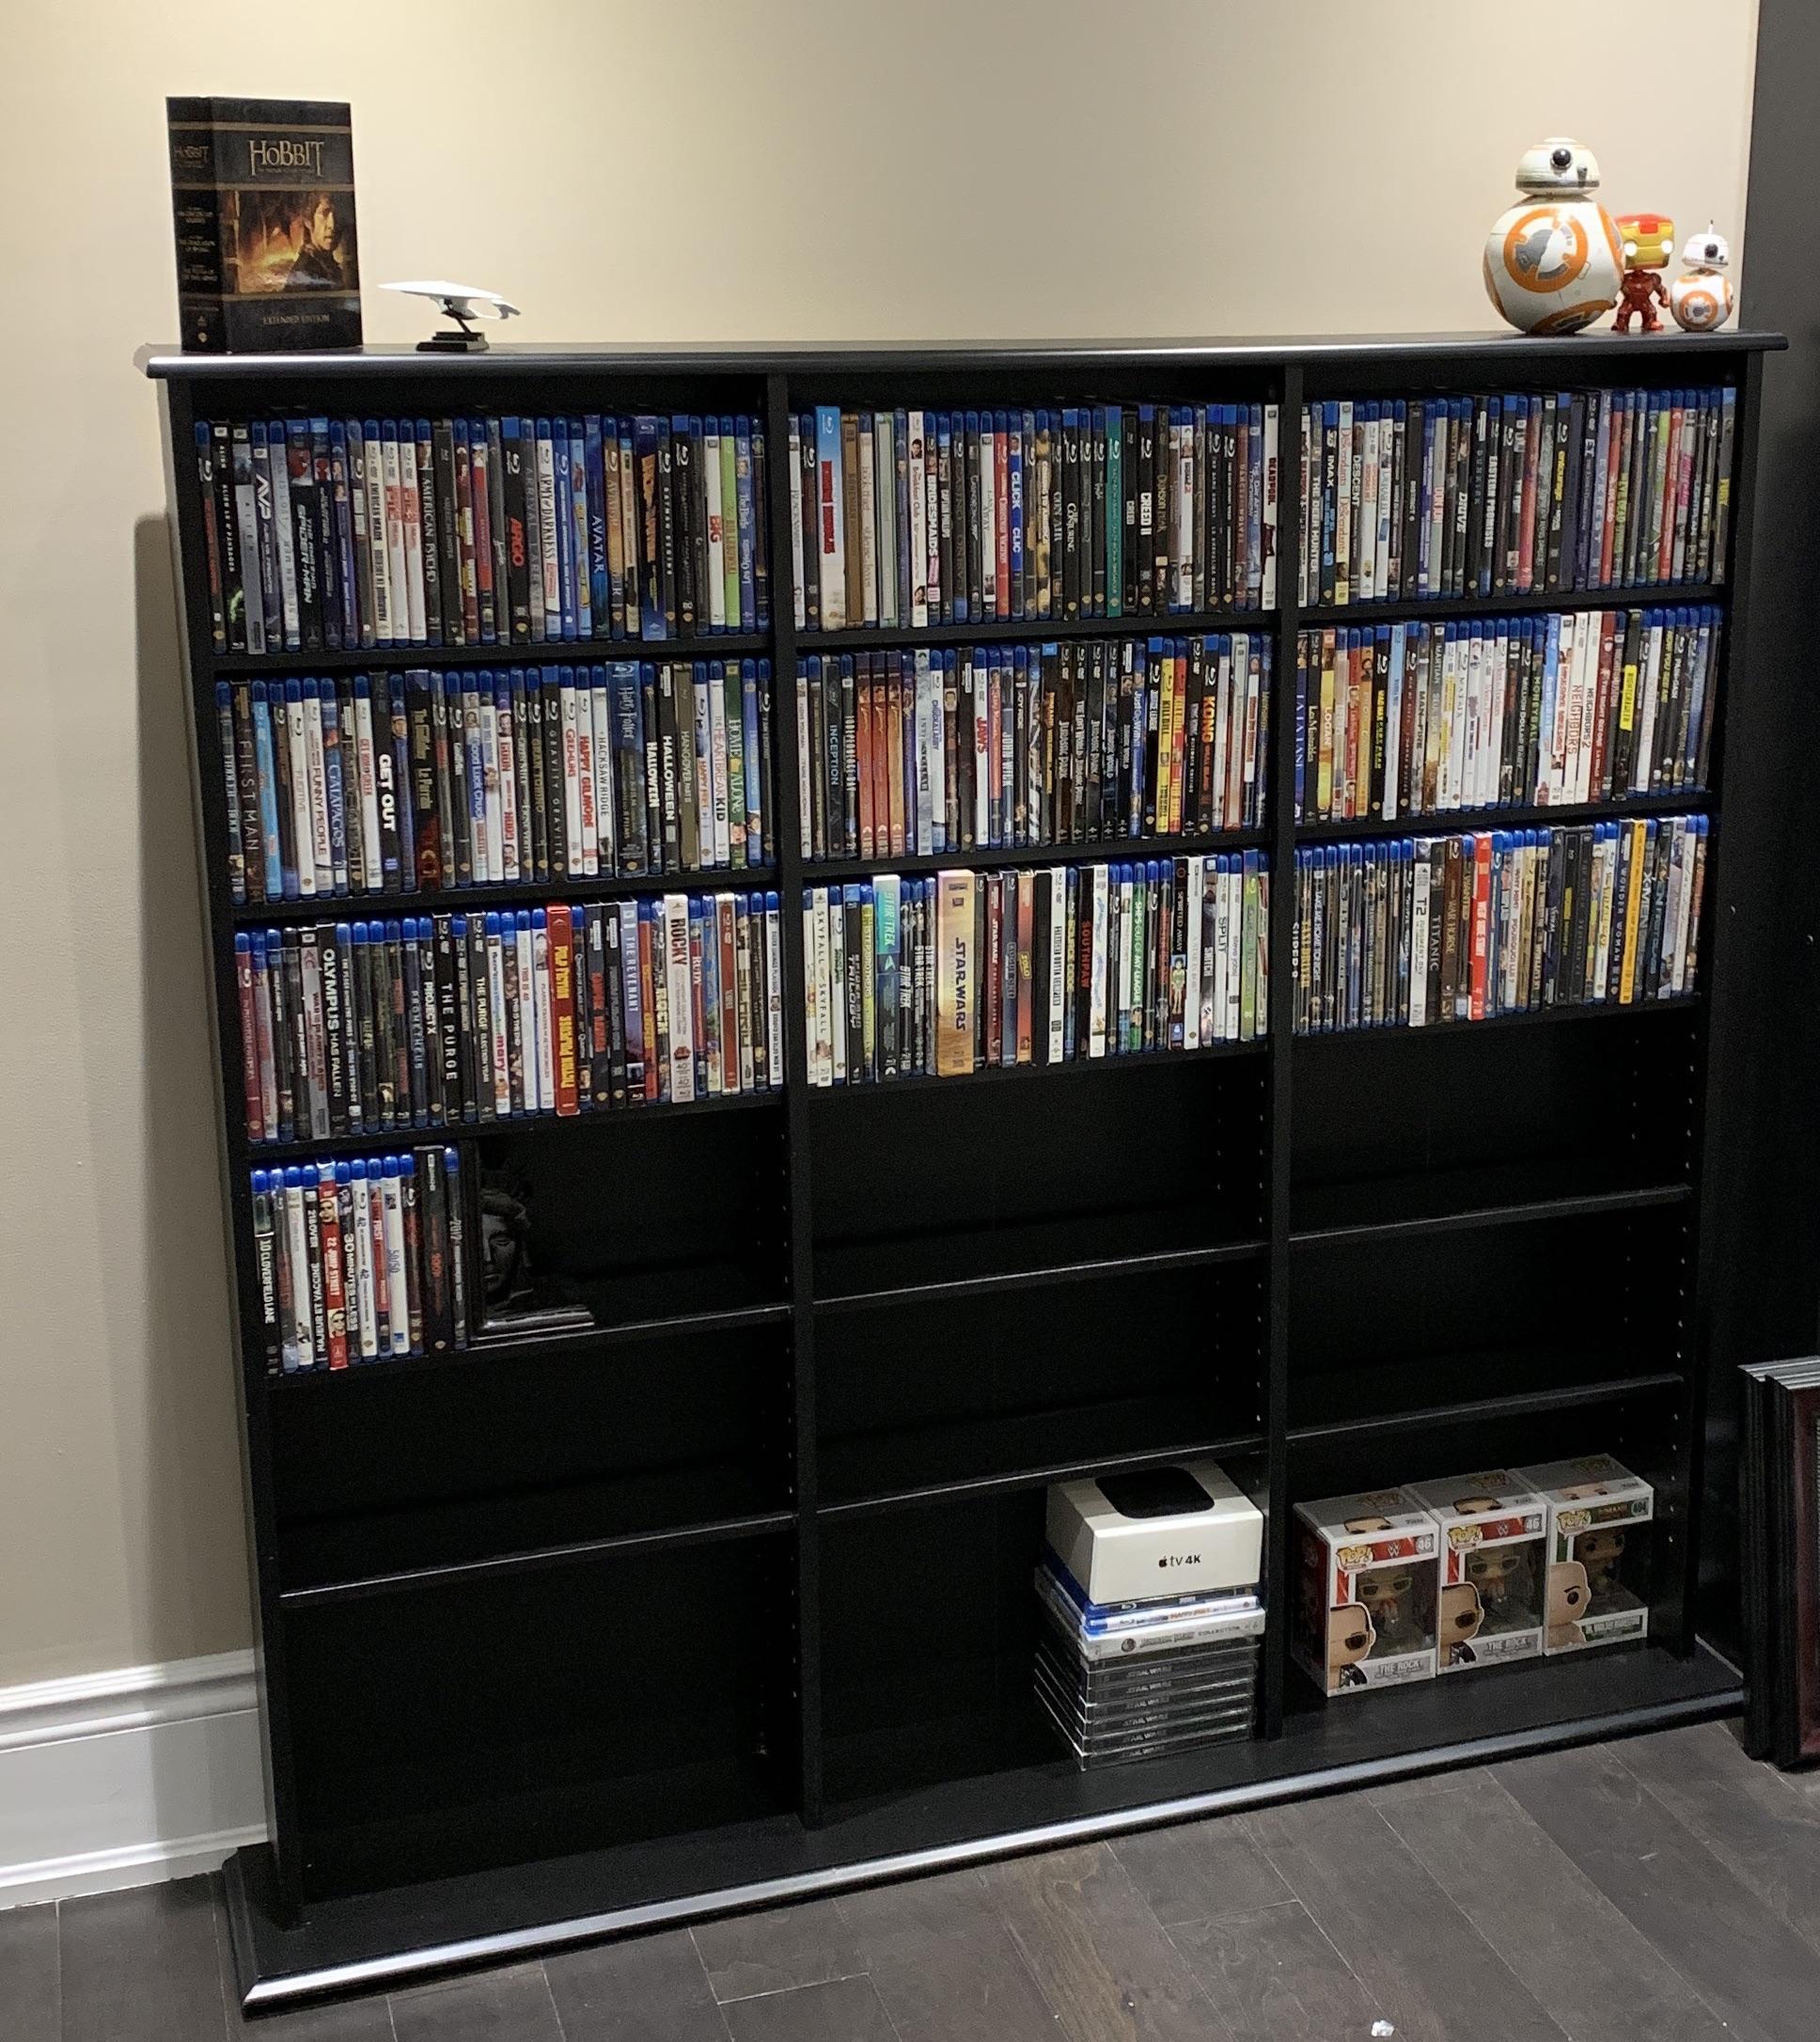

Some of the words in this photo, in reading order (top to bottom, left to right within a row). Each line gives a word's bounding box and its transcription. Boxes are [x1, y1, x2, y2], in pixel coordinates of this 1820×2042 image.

[541, 473, 552, 500] ARMY
[1012, 471, 1021, 510] CLICK
[1267, 458, 1277, 505] DEADPOOL
[1326, 455, 1336, 488] IMAX
[1352, 454, 1362, 507] DESCENT
[1474, 449, 1483, 505] DUNKIRK
[1487, 455, 1498, 497] EASTERN
[1555, 450, 1565, 501] entourage
[256, 474, 272, 520] AVP
[422, 478, 433, 537] AMERICAN
[913, 502, 921, 518] Club
[1126, 500, 1135, 525] CREED
[1140, 493, 1152, 526] CREED
[1456, 492, 1467, 533] DRIVE
[1593, 458, 1607, 543] EVEREST
[1718, 479, 1730, 507] FURY
[542, 509, 557, 559] DARKNESS
[709, 515, 722, 543] BIG
[927, 475, 938, 557] BRIDESMAIDS
[1054, 521, 1062, 542] AIR
[1066, 503, 1076, 552] CONJURING
[1311, 500, 1320, 528] DEER
[1484, 499, 1496, 548] PROMISES
[297, 504, 312, 603] SPIDER-MAN
[510, 517, 525, 567] ARGO
[591, 515, 604, 573] AVATAR
[1012, 527, 1021, 553] CLIC
[1310, 530, 1320, 573] HUNTER
[425, 542, 435, 583] PSYCHO
[1434, 644, 1442, 683] MARTIAN
[1202, 696, 1215, 743] KONG
[1324, 706, 1332, 746] LOGAN
[1530, 676, 1541, 745] MONEYBALL
[1583, 687, 1594, 740] NEIGHBORS
[580, 735, 591, 771] HAPPY
[729, 718, 742, 758] HOME
[829, 724, 839, 786] INCEPTION
[977, 716, 987, 755] JAWS
[1416, 724, 1424, 749] FIRE
[239, 740, 256, 800] FIRST
[379, 754, 393, 790] GET
[473, 766, 481, 789] Luck
[598, 737, 606, 784] HACKSAW
[647, 742, 659, 808] HALLOWEEN
[663, 736, 674, 821] HALLOWEEN
[714, 728, 725, 797] HEARTBREAK
[313, 767, 323, 808] FUNNY
[582, 777, 593, 827] GILMORE
[601, 787, 609, 816] RIDGE
[382, 793, 396, 832] OUT
[715, 797, 726, 822] KID
[243, 809, 259, 851] MAN
[316, 810, 327, 856] PEOPLE
[1416, 897, 1427, 916] T2
[1617, 867, 1626, 914] WONDER
[1447, 901, 1456, 921] WAR
[625, 935, 635, 957] THE
[670, 918, 687, 966] ROCKY
[885, 919, 896, 947] TREK
[1067, 919, 1075, 961] SOURCE
[1217, 917, 1226, 954] SPLIT
[1430, 916, 1440, 971] TITANIC
[1446, 923, 1455, 955] HORSE
[1613, 921, 1624, 962] WOMAN
[692, 956, 701, 986] RUDY
[1081, 919, 1090, 989] SOUTHPAW
[322, 949, 340, 1030] OLYMPUS
[424, 982, 435, 1027] PROJECT
[441, 983, 454, 1014] THE
[477, 977, 486, 997] THE
[329, 1032, 340, 1056] HAS
[445, 1025, 457, 1080] PURGE
[494, 1035, 505, 1072] mary
[331, 1058, 341, 1097] FALLEN
[327, 1236, 336, 1247] 22
[357, 1217, 366, 1227] 42
[450, 1219, 463, 1240] 2012
[259, 1239, 270, 1251] 10
[344, 1233, 353, 1252] 30
[260, 1252, 273, 1302] CLOVERFIELD
[346, 1253, 356, 1296] MINUTES
[360, 1268, 369, 1279] 42
[264, 1303, 275, 1324] LANE
[315, 1315, 325, 1352] MAJEUR
[349, 1306, 358, 1331] LESS
[1169, 1555, 1183, 1566] tv
[1185, 1554, 1201, 1564] 4K
[1417, 1539, 1432, 1551] 46
